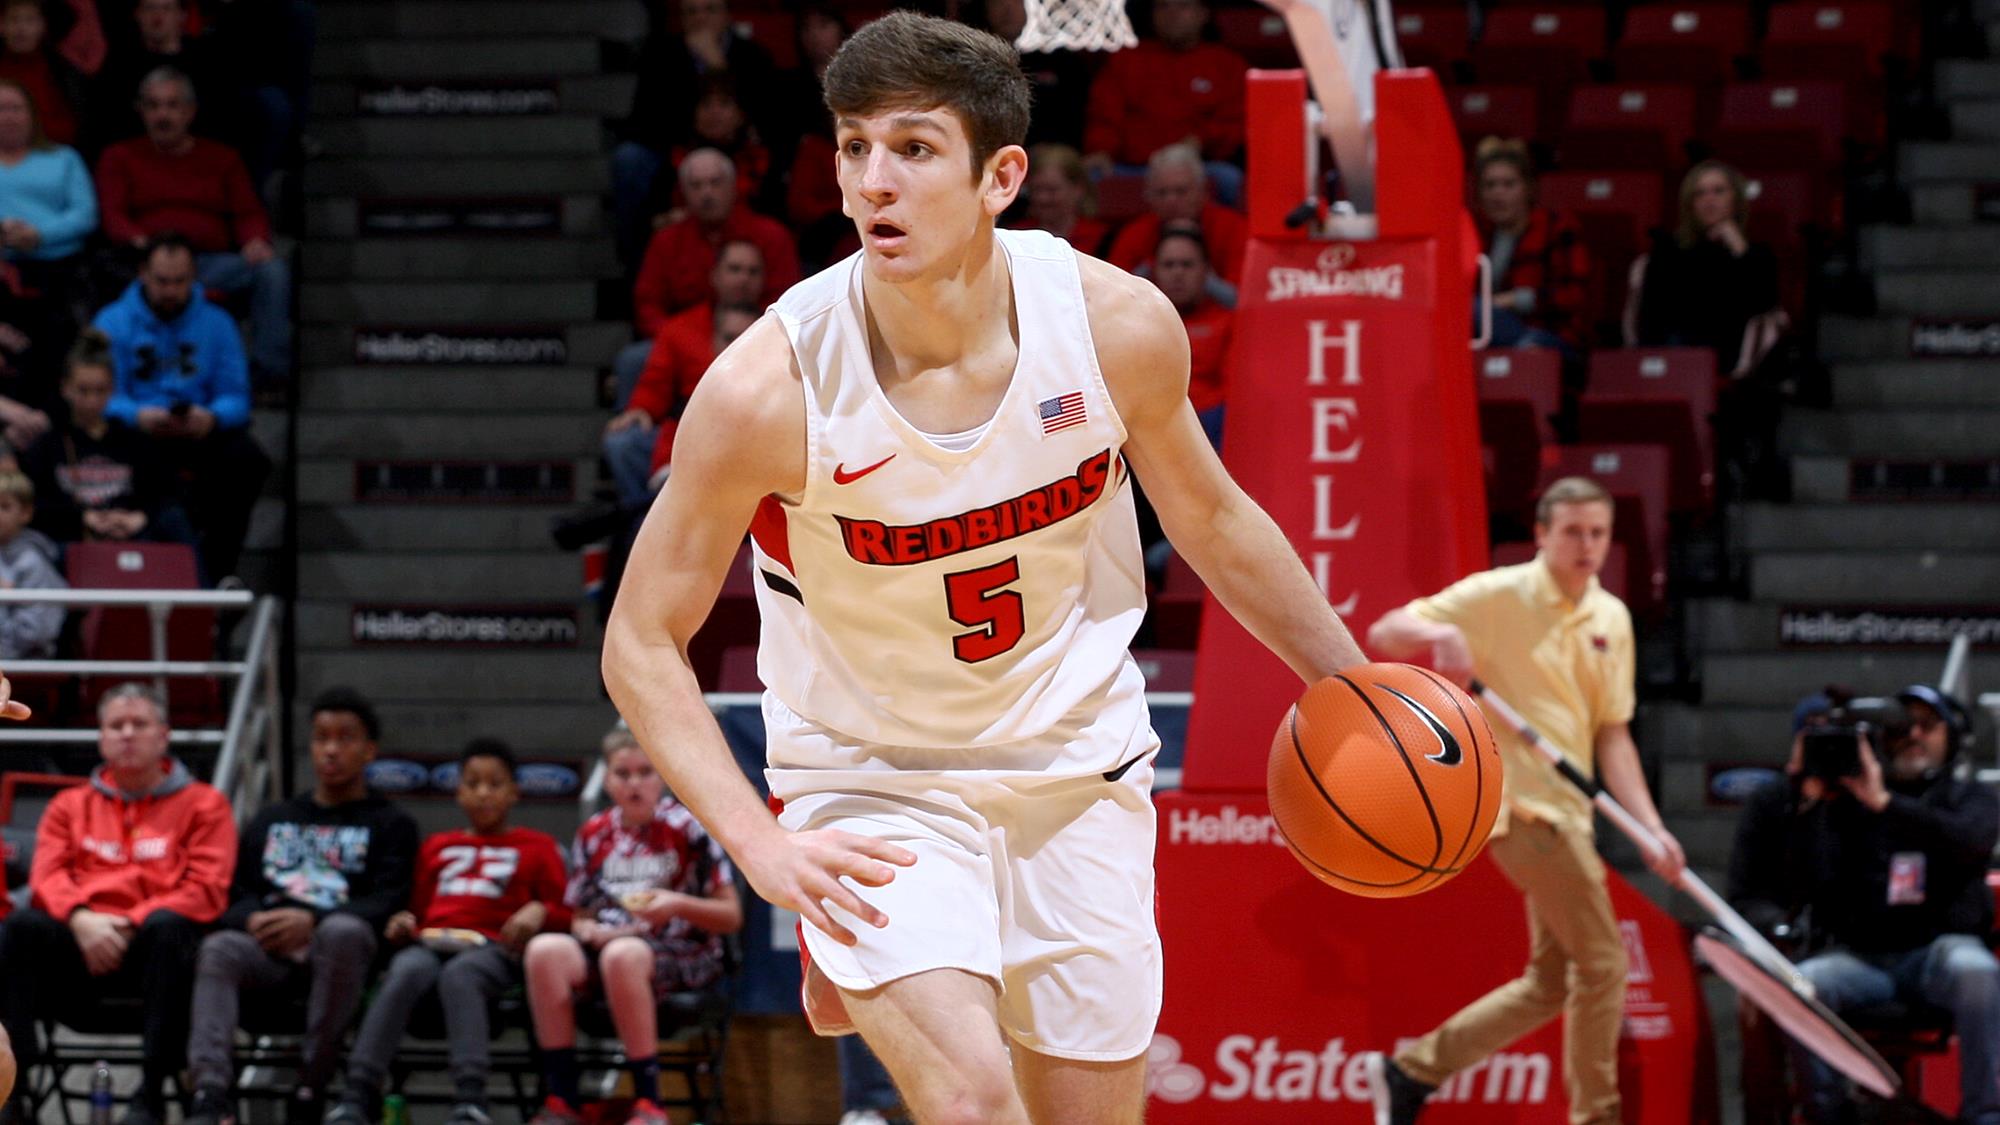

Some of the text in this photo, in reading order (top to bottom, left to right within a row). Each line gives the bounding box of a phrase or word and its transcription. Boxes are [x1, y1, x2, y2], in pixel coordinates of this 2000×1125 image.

[1267, 264, 1404, 301] SPALDING
[831, 447, 1111, 566] REDBIRDS
[354, 611, 577, 641] HellerStores.com
[944, 555, 1025, 664] 5
[1169, 805, 1286, 847] Heller
[437, 845, 519, 898] 23
[1210, 1034, 1374, 1101] State
